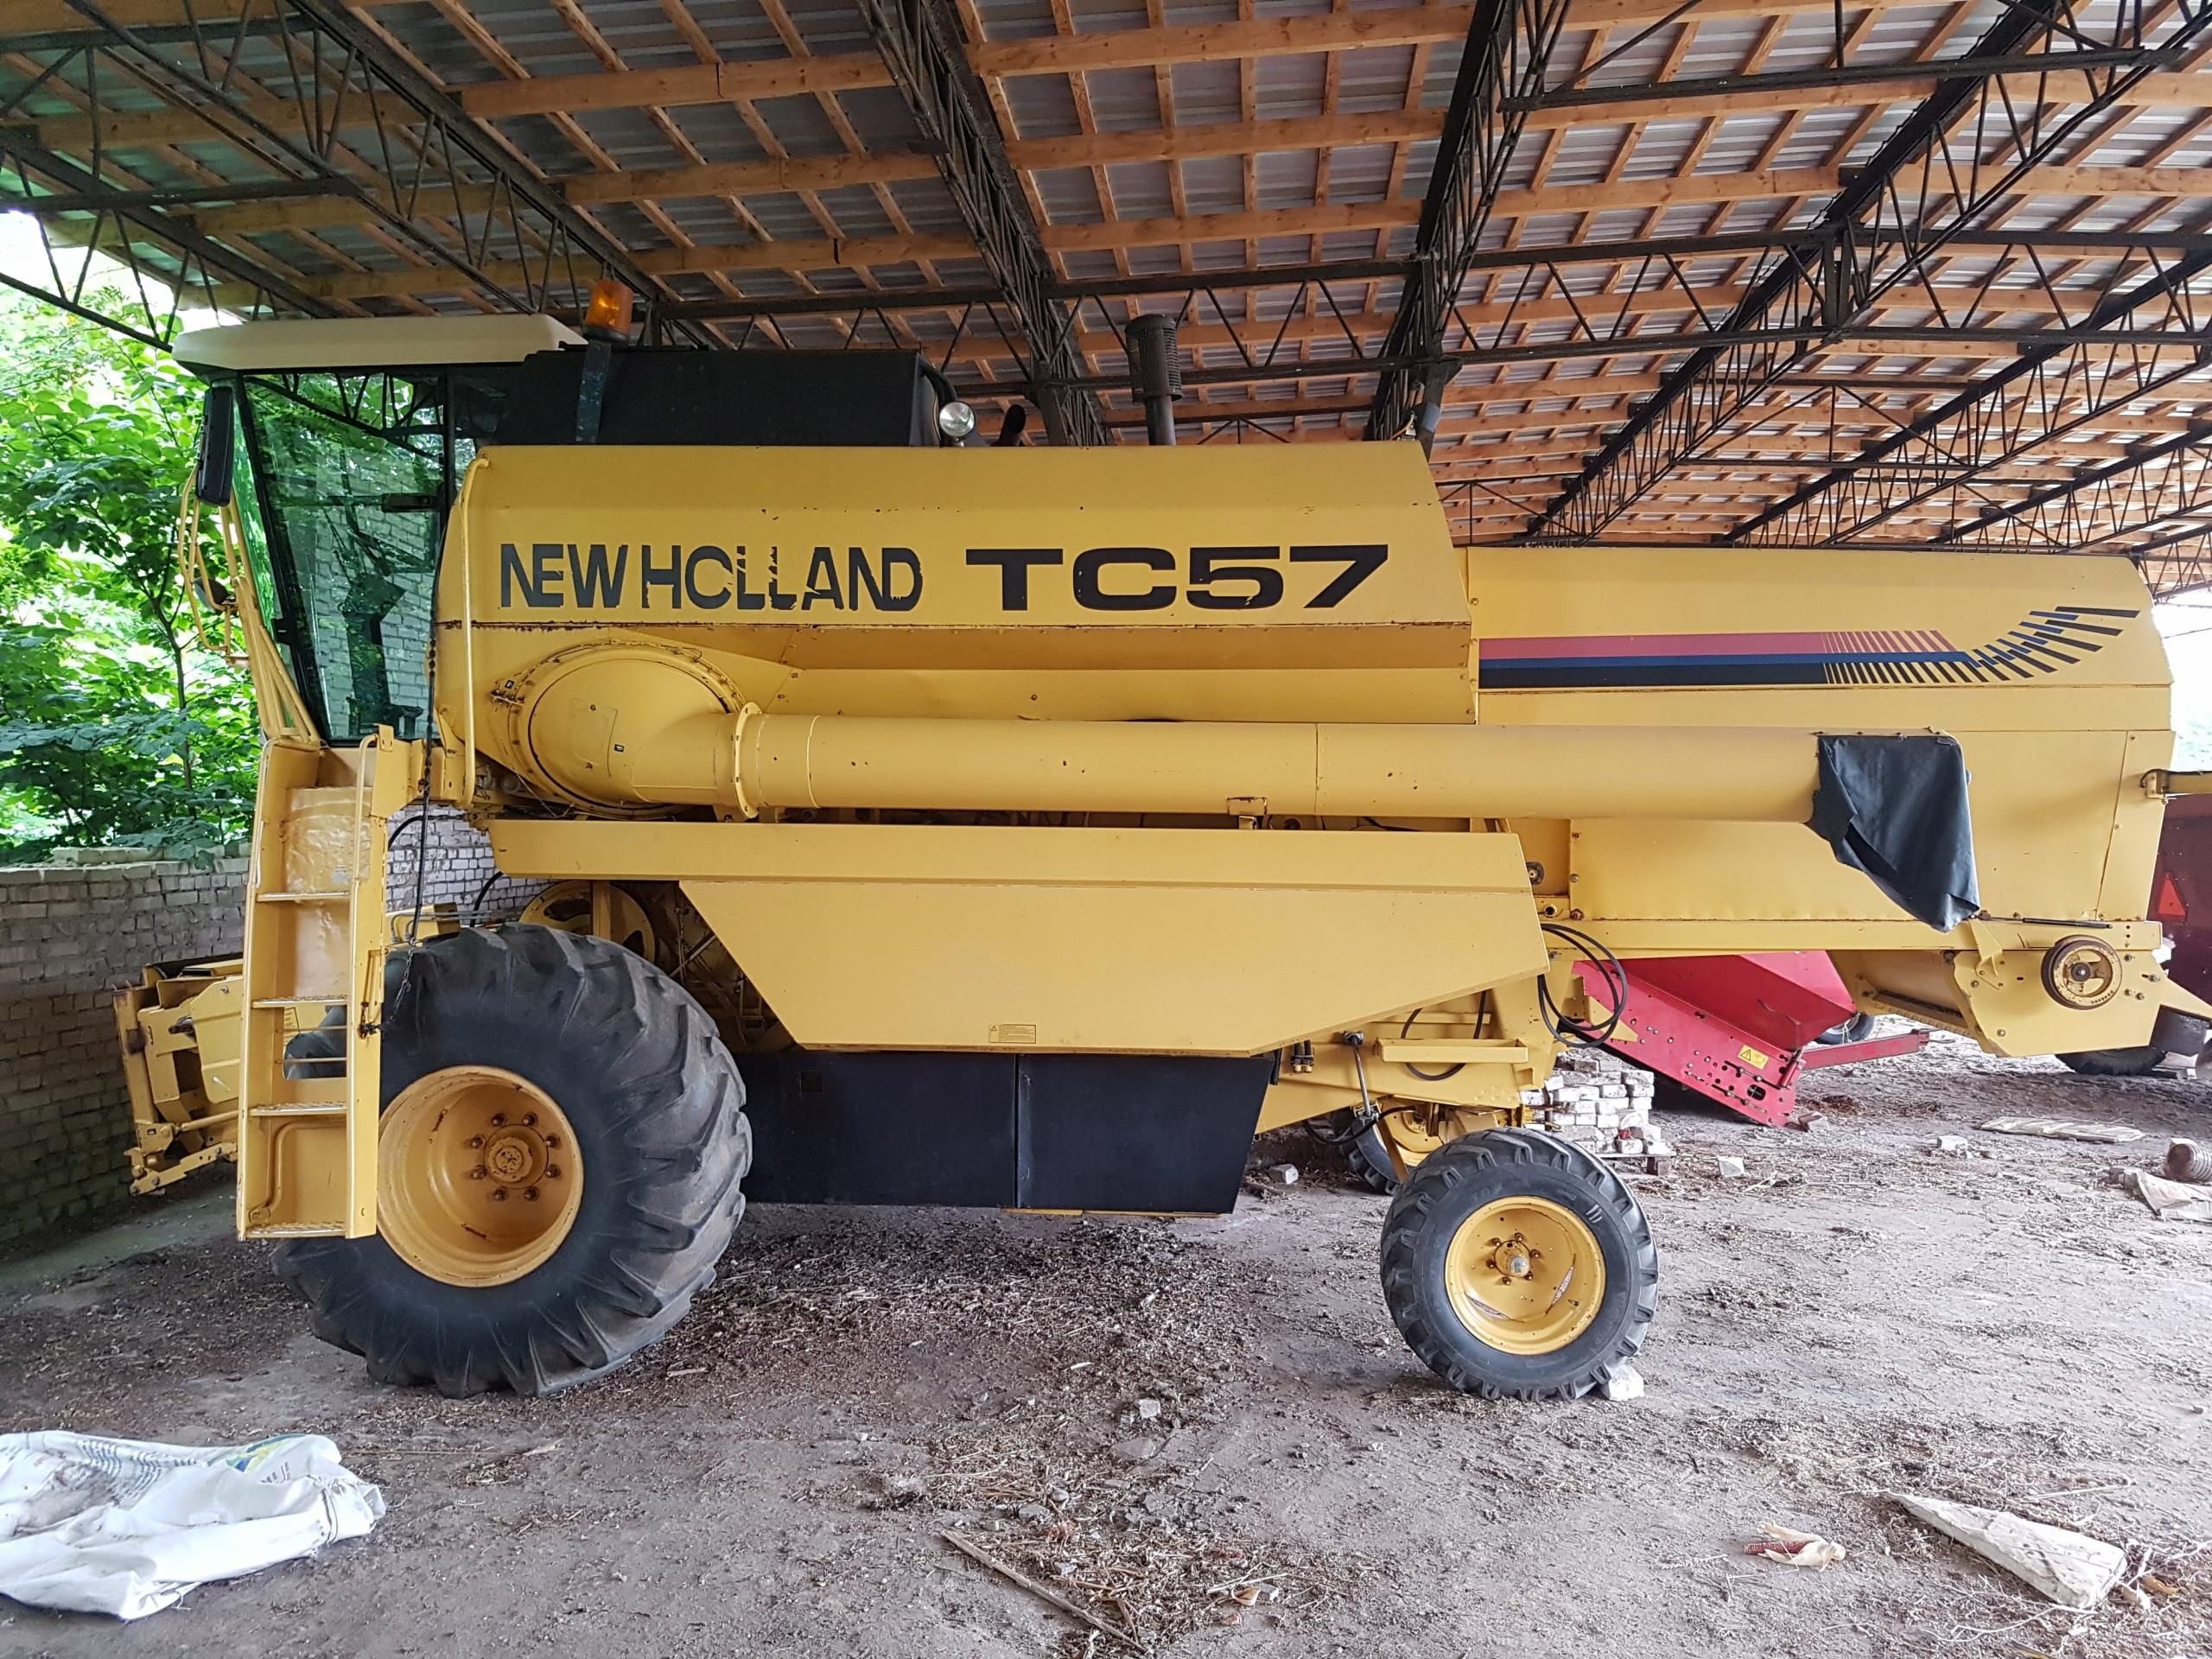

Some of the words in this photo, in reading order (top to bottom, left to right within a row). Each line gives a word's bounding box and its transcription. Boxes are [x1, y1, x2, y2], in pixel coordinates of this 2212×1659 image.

[500, 543, 628, 608] NEW
[641, 545, 923, 611] HOLLAND
[966, 545, 1388, 610] TC57
